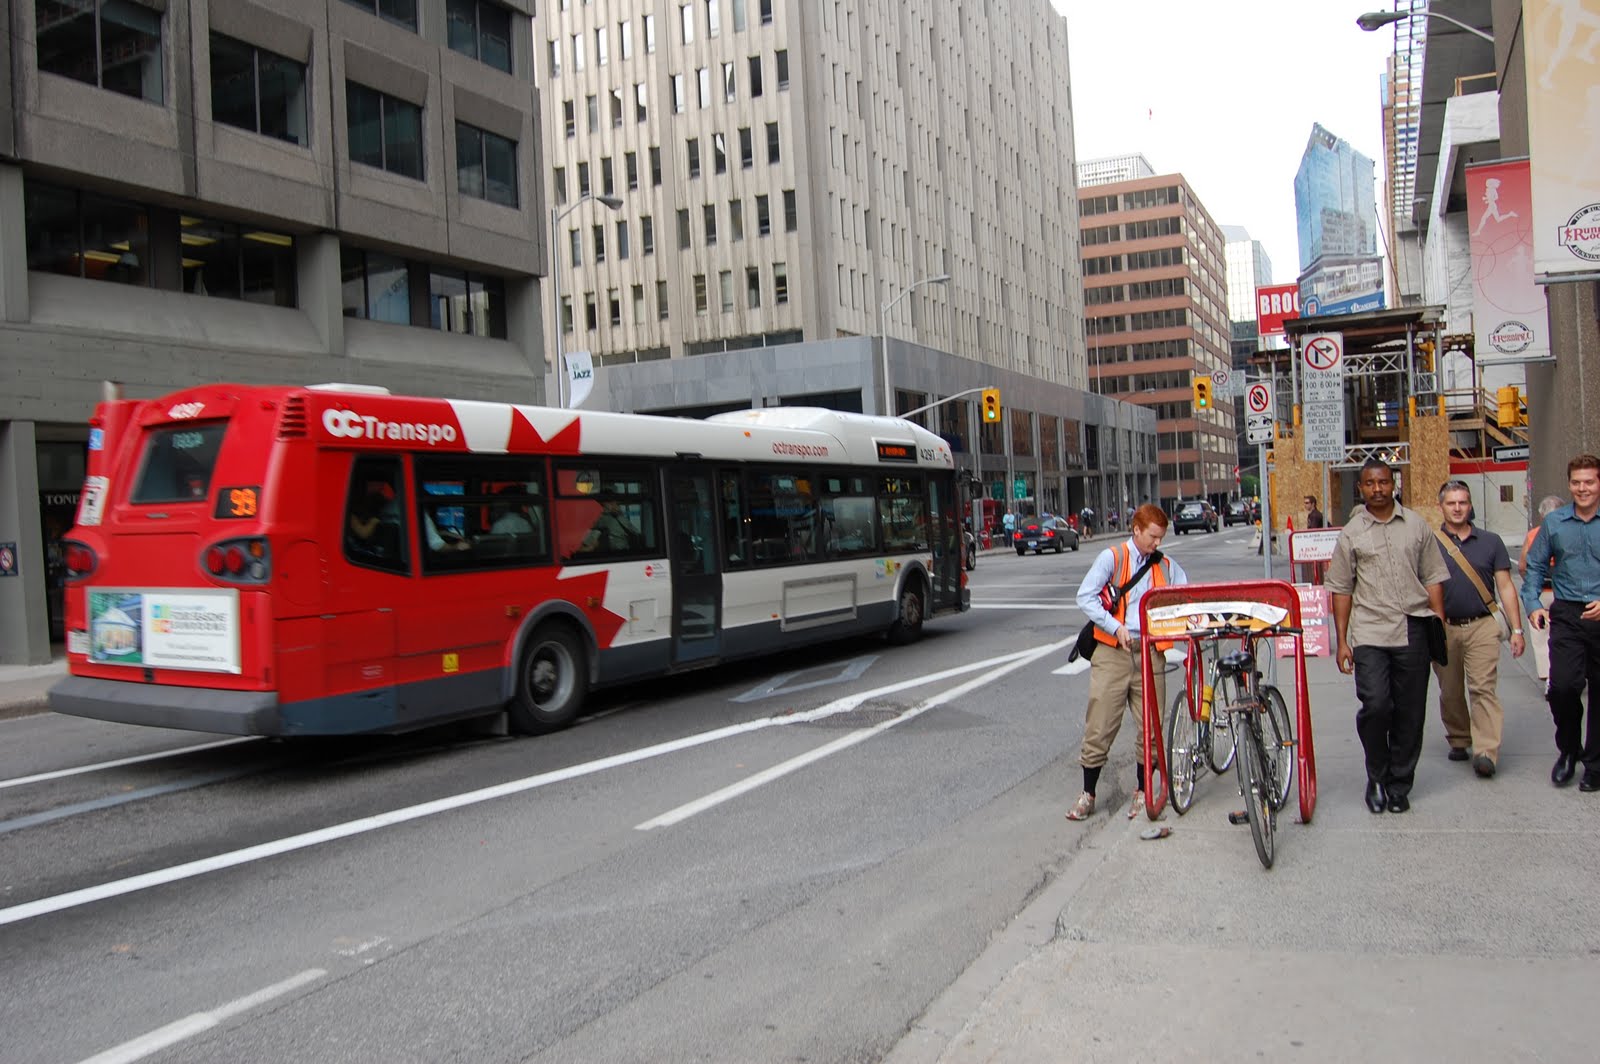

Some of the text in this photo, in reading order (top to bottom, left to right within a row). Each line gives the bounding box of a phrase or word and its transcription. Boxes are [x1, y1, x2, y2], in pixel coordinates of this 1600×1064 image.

[573, 370, 591, 380] JAZZ
[772, 441, 829, 459] octranspo.com
[920, 448, 936, 461] 4297
